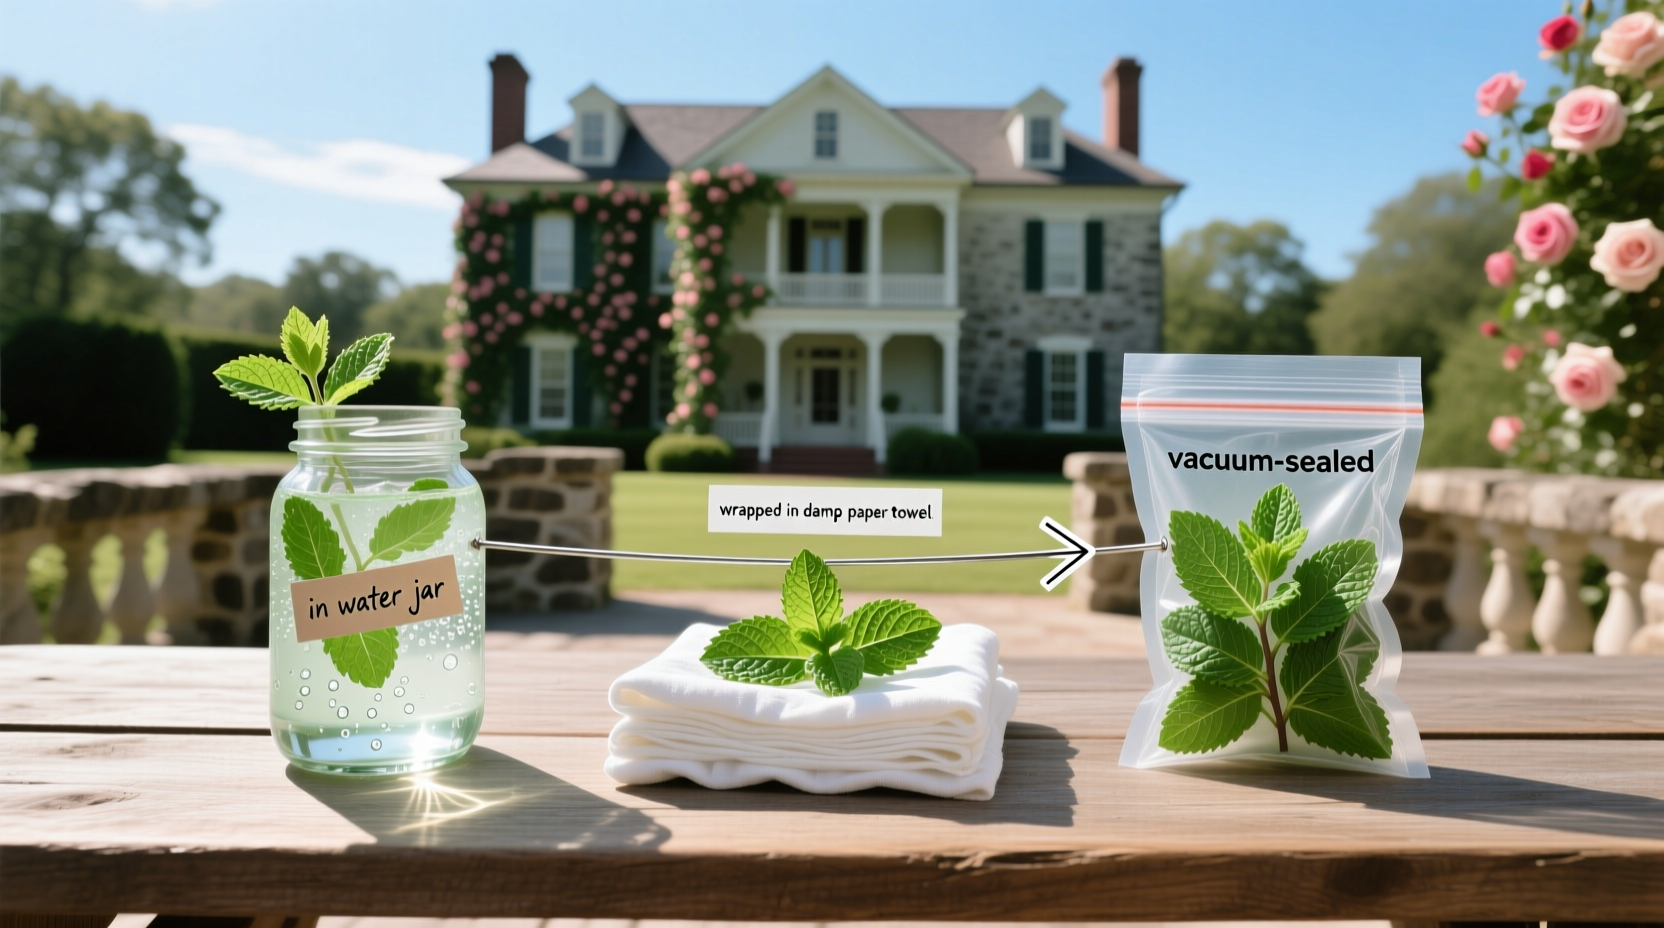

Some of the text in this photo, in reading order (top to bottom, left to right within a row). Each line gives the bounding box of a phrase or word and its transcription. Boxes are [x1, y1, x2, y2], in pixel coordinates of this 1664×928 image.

[1168, 449, 1374, 473] vacuum-sealed
[309, 579, 445, 620] in water jar
